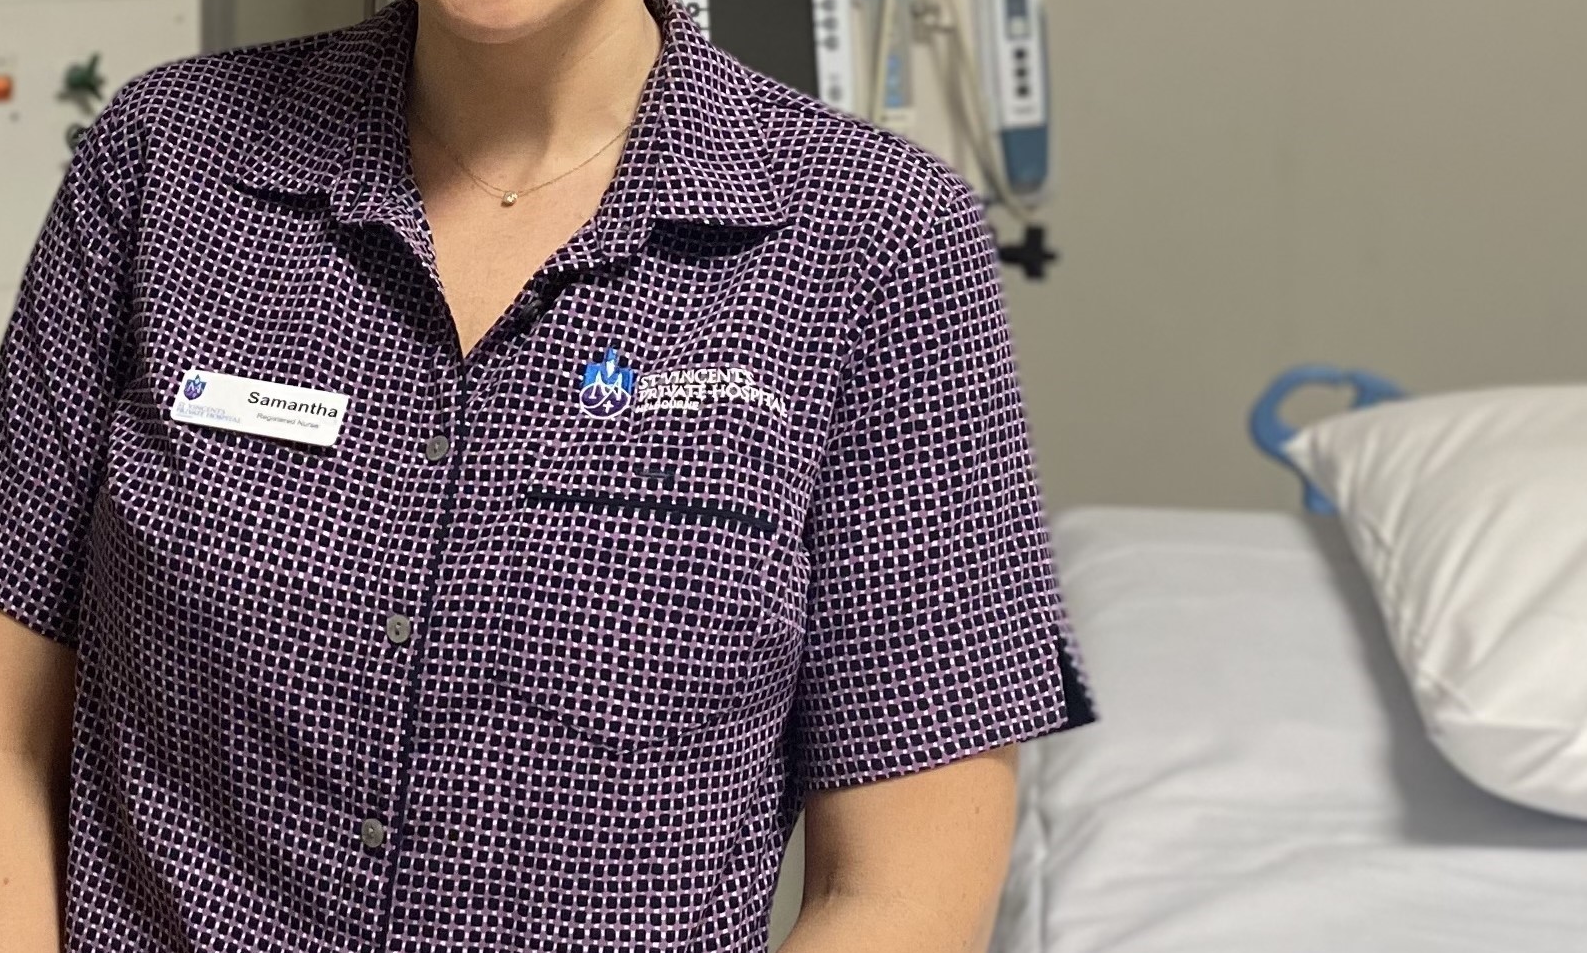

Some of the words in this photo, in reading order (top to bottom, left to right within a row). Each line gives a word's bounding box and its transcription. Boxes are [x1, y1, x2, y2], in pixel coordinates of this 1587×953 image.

[638, 374, 661, 390] ST
[247, 391, 338, 418] Samantha
[638, 383, 707, 402] PRIVATE
[711, 382, 788, 418] HOSPITAL
[256, 412, 296, 425] Registered
[297, 417, 319, 429] Nurse
